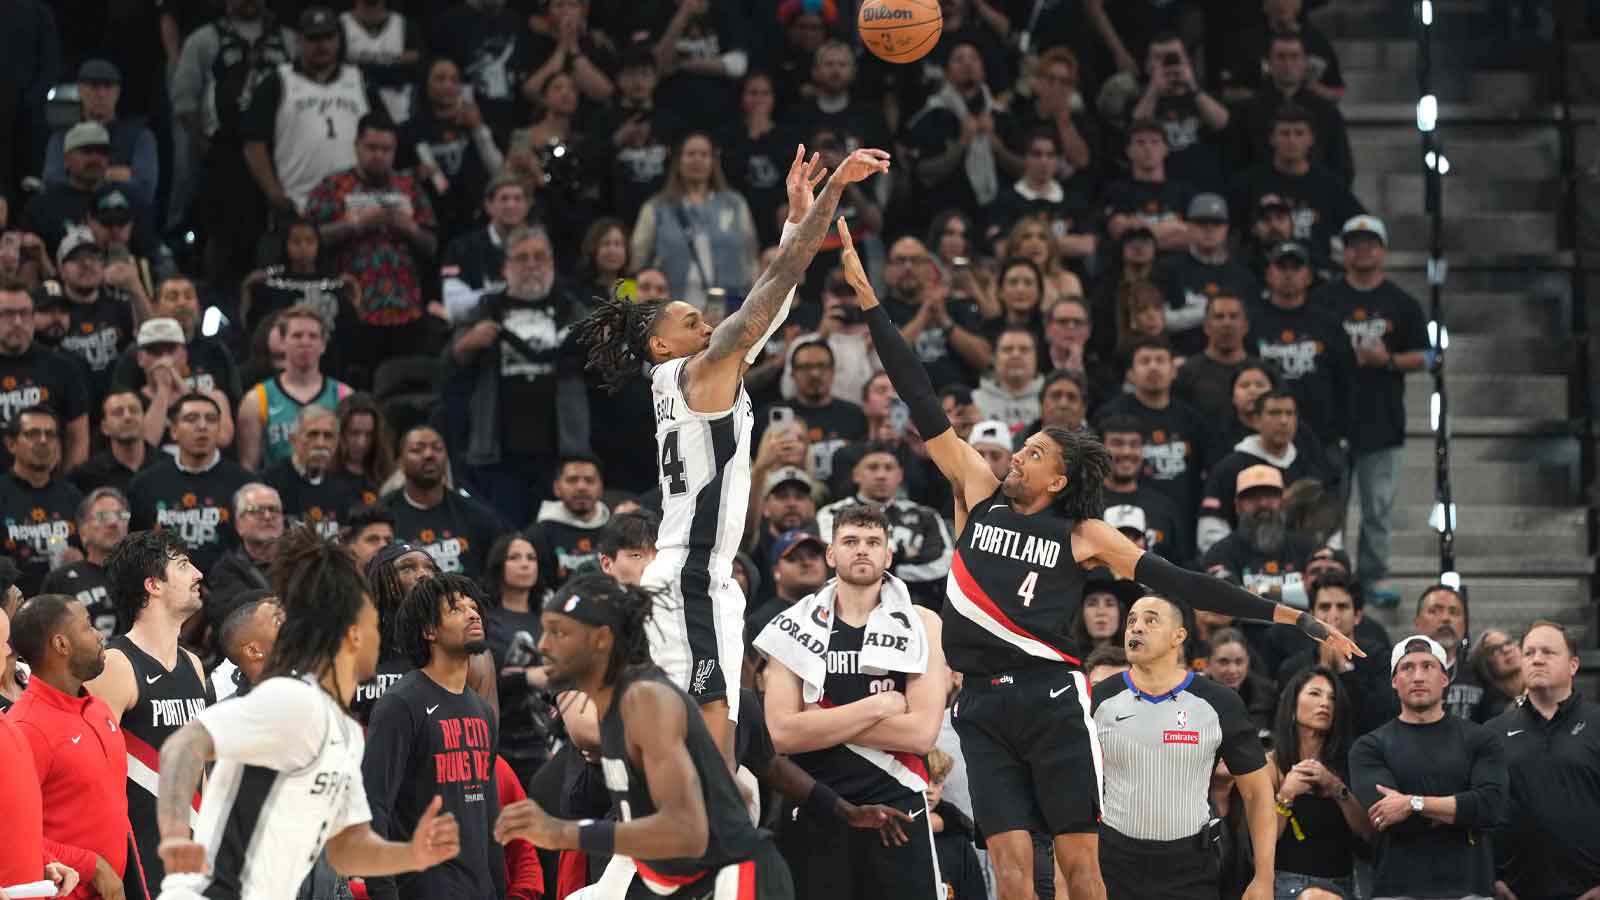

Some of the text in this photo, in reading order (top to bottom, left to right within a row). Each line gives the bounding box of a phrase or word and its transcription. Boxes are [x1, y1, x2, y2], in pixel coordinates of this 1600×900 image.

[863, 7, 912, 21] Wilson
[970, 522, 1061, 570] PORTLAND
[1017, 571, 1039, 608] 4
[438, 719, 461, 750] RIP
[1164, 733, 1198, 742] Emirates
[433, 751, 472, 784] RUNS
